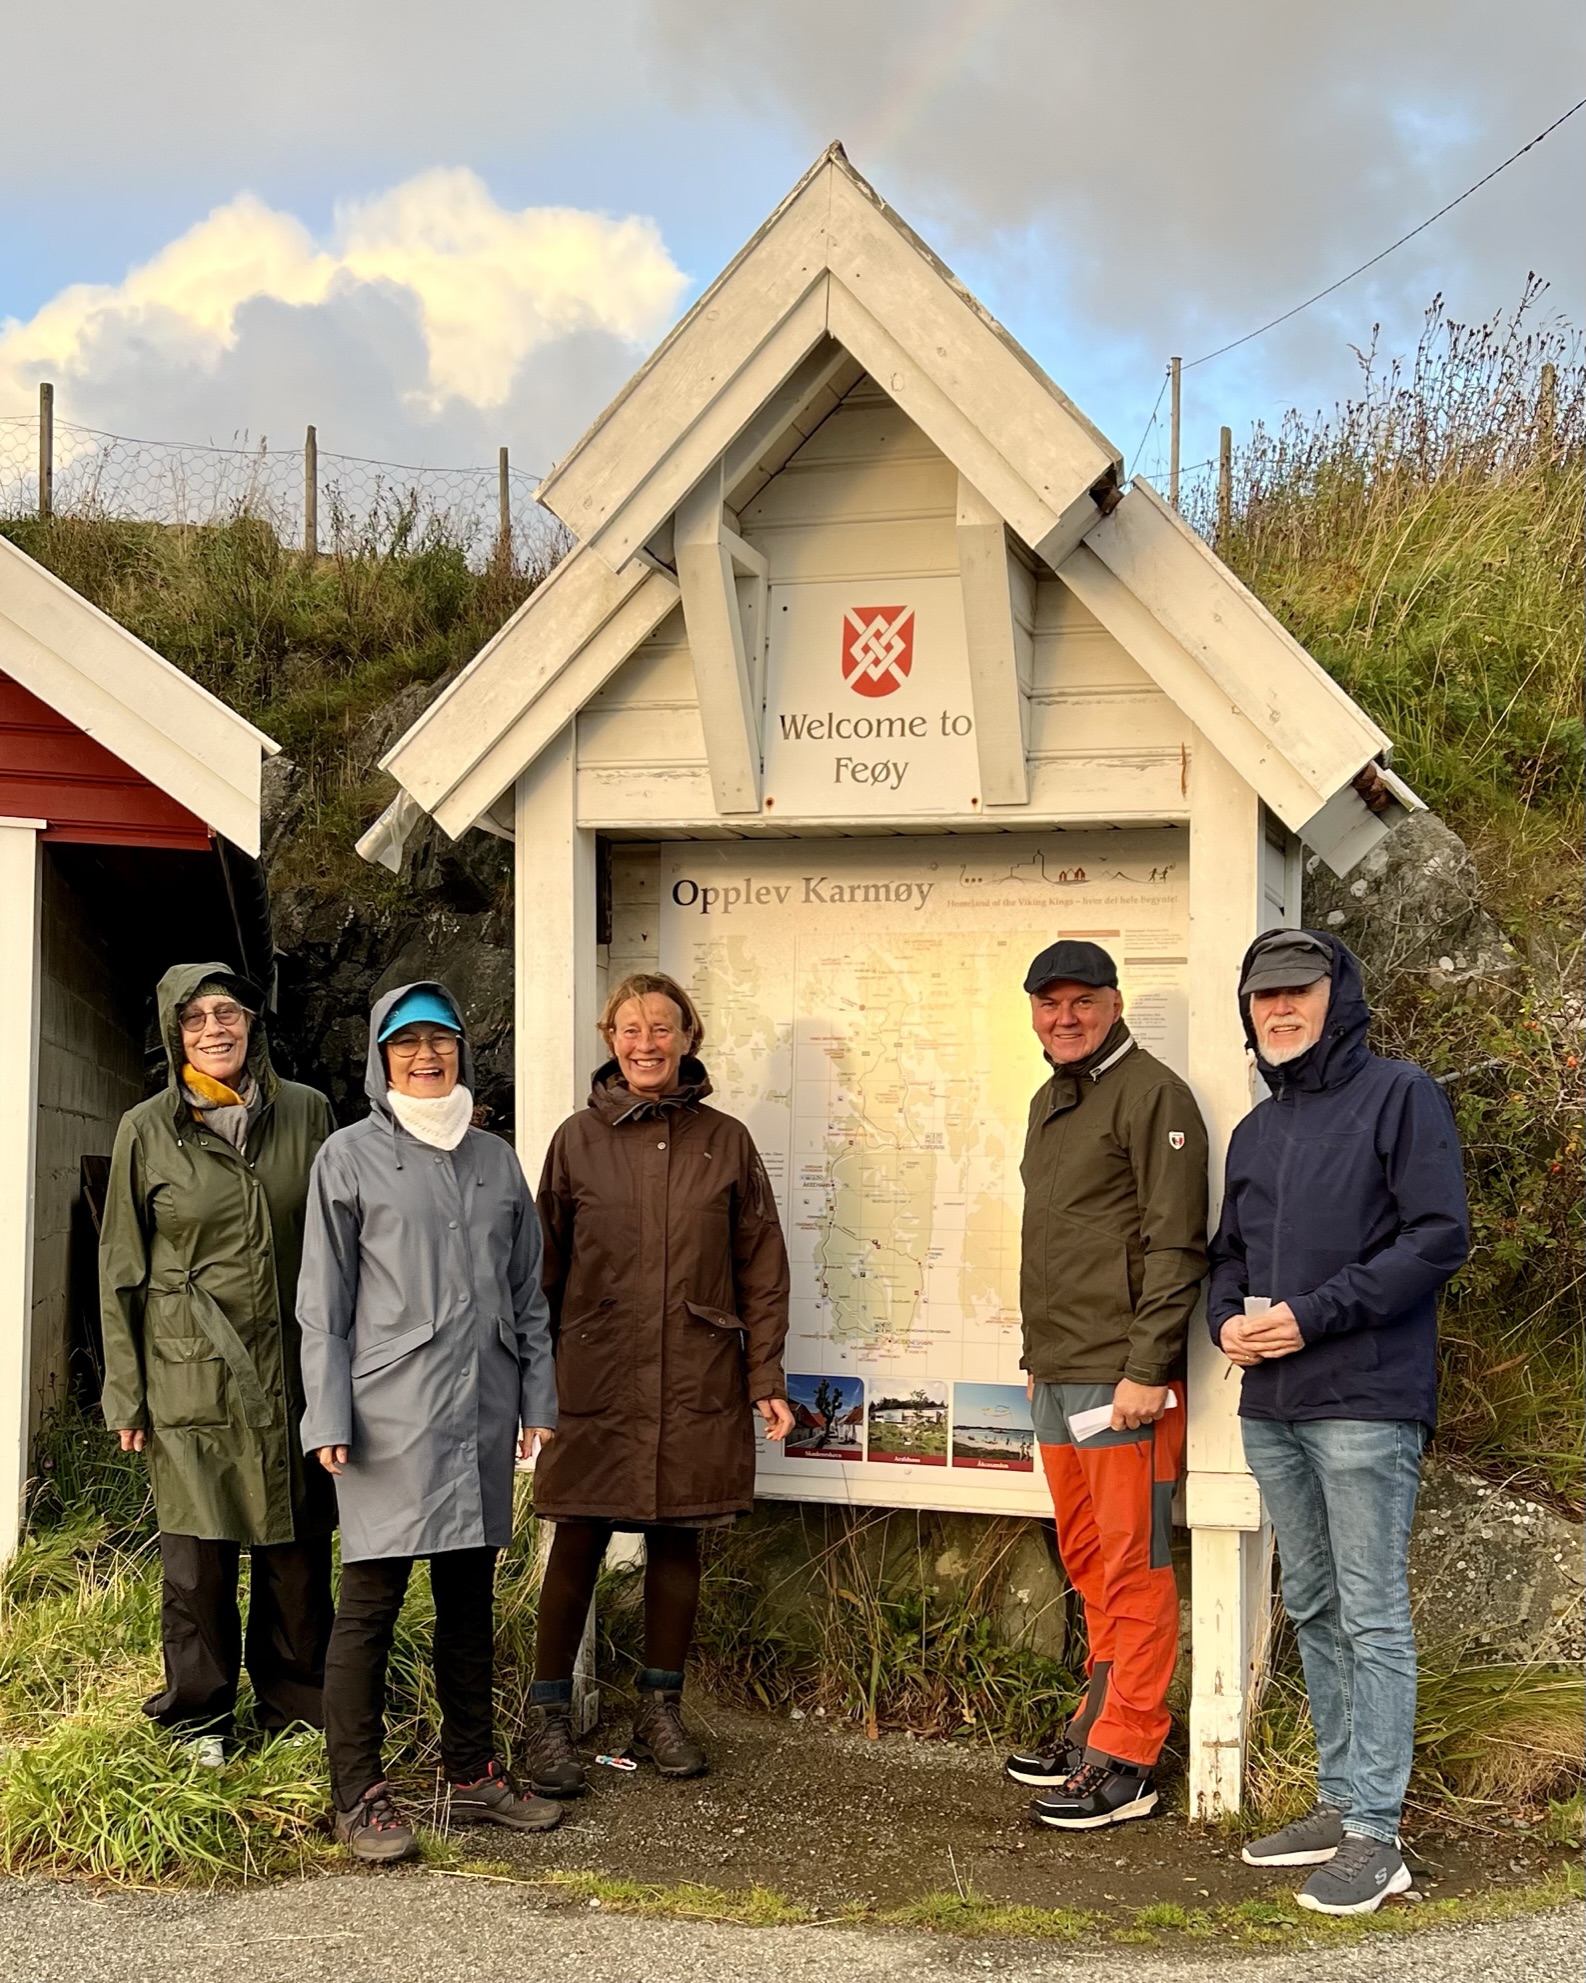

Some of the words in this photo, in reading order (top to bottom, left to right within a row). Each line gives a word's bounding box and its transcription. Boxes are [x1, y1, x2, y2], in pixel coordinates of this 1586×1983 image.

[779, 712, 928, 740] Welcome
[940, 710, 973, 736] to
[833, 756, 910, 790] Feøy
[672, 877, 792, 914] Opplev
[801, 877, 935, 911] Karmøy
[947, 898, 990, 908] Homeland
[992, 898, 1001, 907] of
[1002, 898, 1016, 907] the
[1017, 897, 1047, 908] Viking
[1048, 896, 1074, 908] Kings
[1082, 896, 1103, 905] hvor
[1120, 895, 1139, 904] hele
